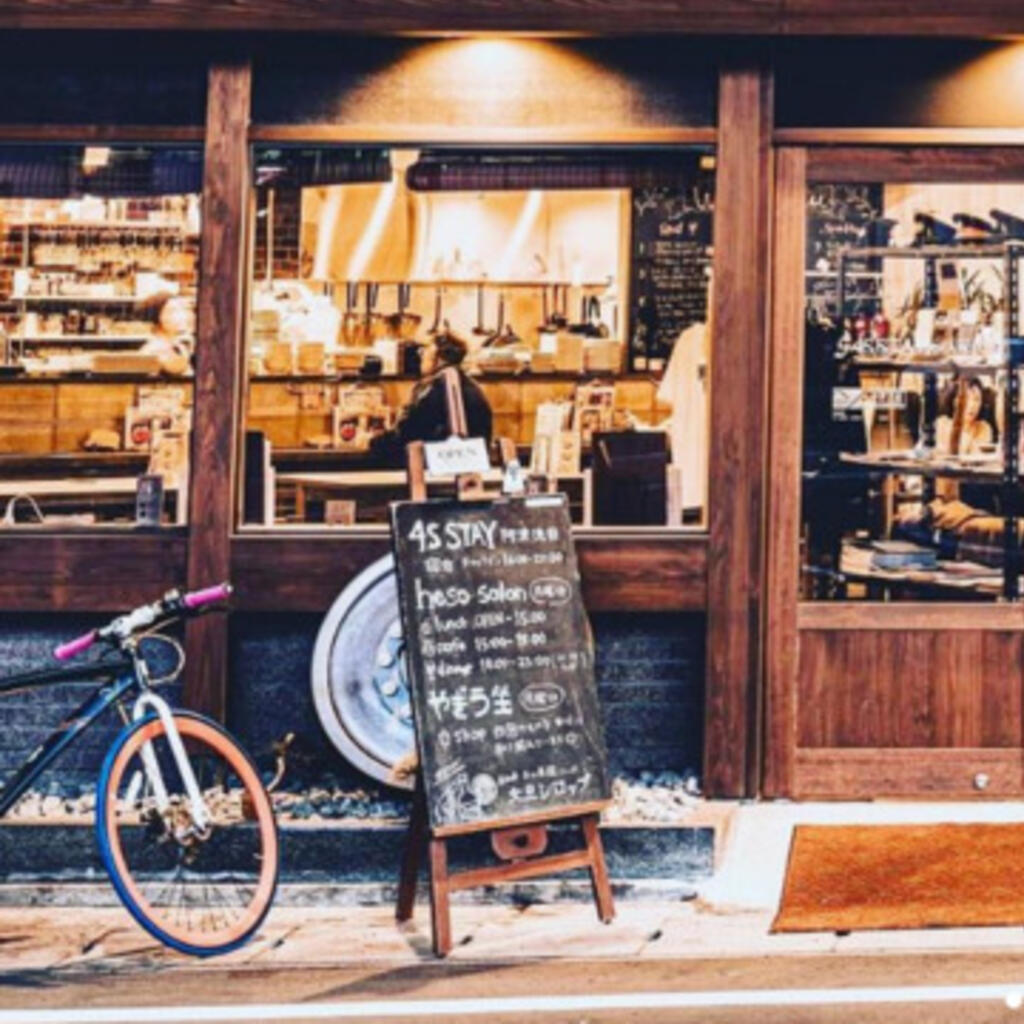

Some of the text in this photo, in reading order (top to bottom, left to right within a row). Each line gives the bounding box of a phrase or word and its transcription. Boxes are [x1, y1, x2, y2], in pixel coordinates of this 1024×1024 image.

[408, 519, 442, 553] 4S
[445, 519, 499, 550] STAY
[477, 580, 527, 604] salon
